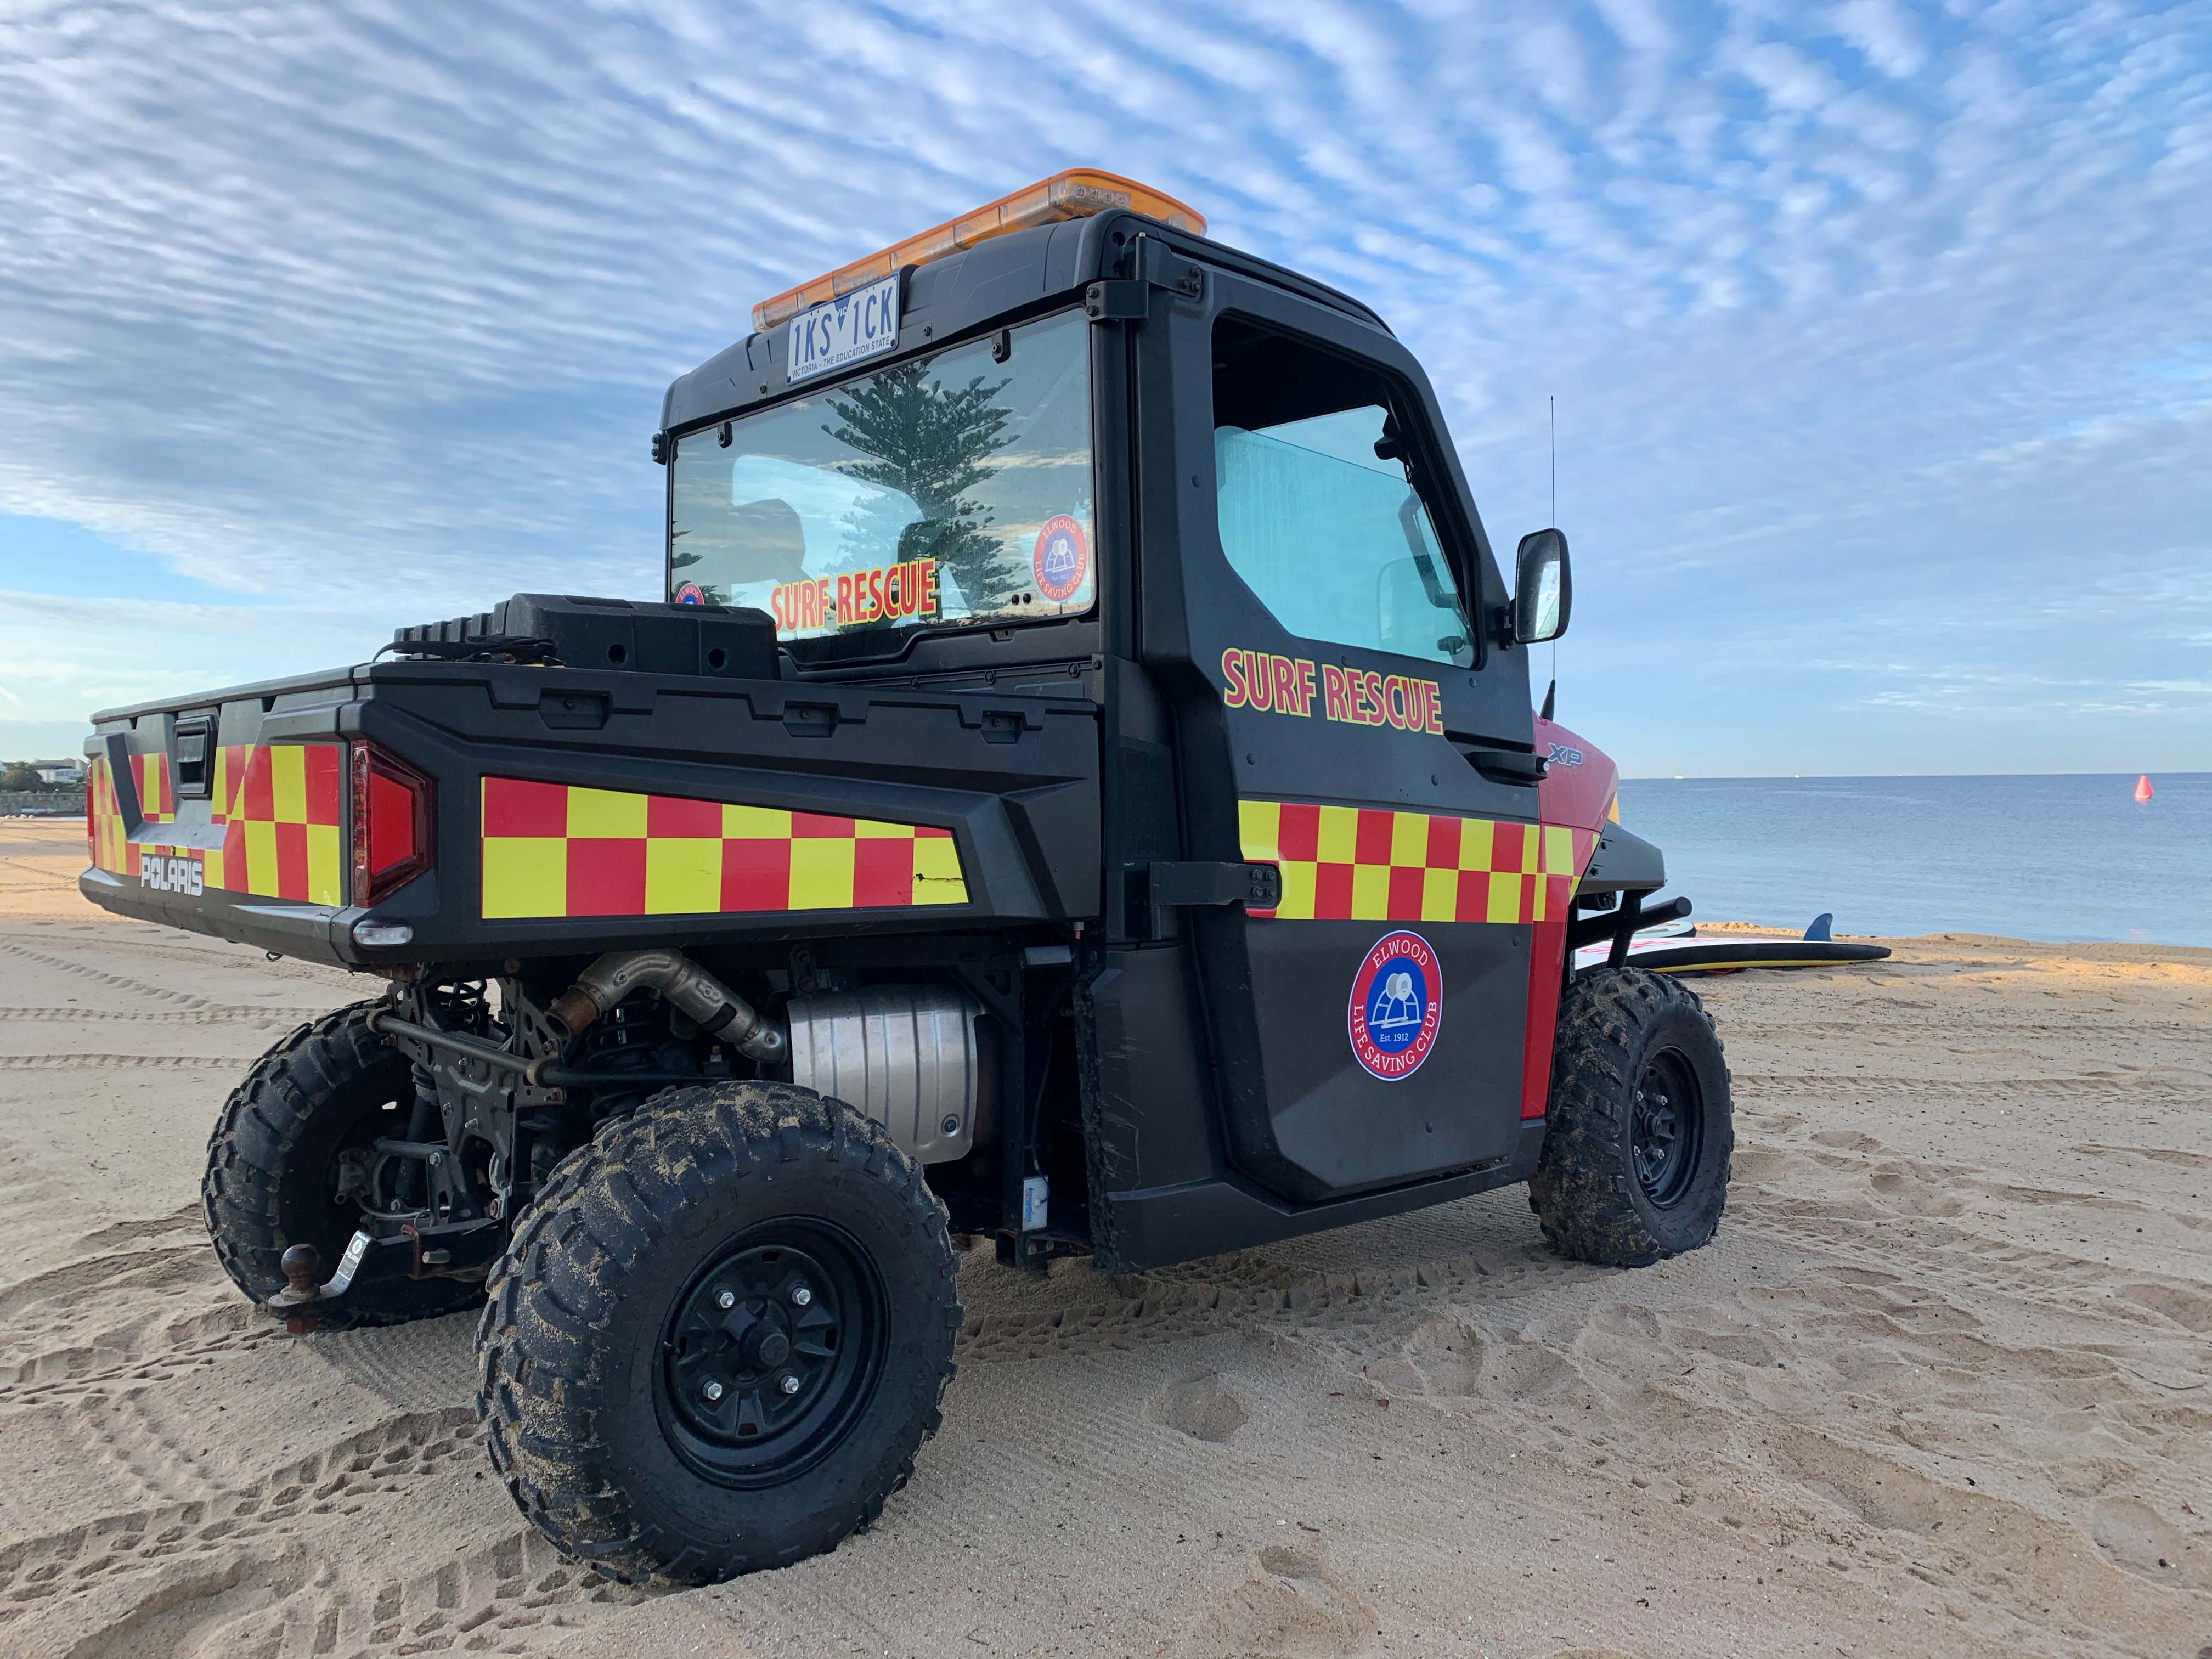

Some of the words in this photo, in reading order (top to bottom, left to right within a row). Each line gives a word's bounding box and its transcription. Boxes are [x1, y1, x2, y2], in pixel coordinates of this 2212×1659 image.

[836, 306, 847, 317] VIC
[792, 363, 817, 378] VICTORIA
[823, 356, 834, 367] THE
[836, 343, 870, 363] EDUCATION
[871, 336, 890, 350] STATE
[1043, 519, 1076, 539] ELWOOD
[1035, 561, 1045, 585] LIFE
[1044, 584, 1073, 597] SAVING
[1073, 553, 1085, 584] CLUB
[680, 587, 699, 599] ELWOOD
[770, 577, 831, 633] SURF
[836, 557, 936, 625] RESCUE
[1221, 647, 1316, 717] SURF
[1322, 664, 1443, 736] RESCUE
[1547, 742, 1583, 766] XP
[141, 857, 202, 896] POLARIS
[1372, 939, 1428, 969] ELWOOD
[1354, 1004, 1368, 1048] LIFE
[1365, 1046, 1415, 1071] SAVING
[1417, 1001, 1437, 1052] CLUB
[1380, 1034, 1391, 1042] Est.
[1393, 1032, 1409, 1042] 1912
